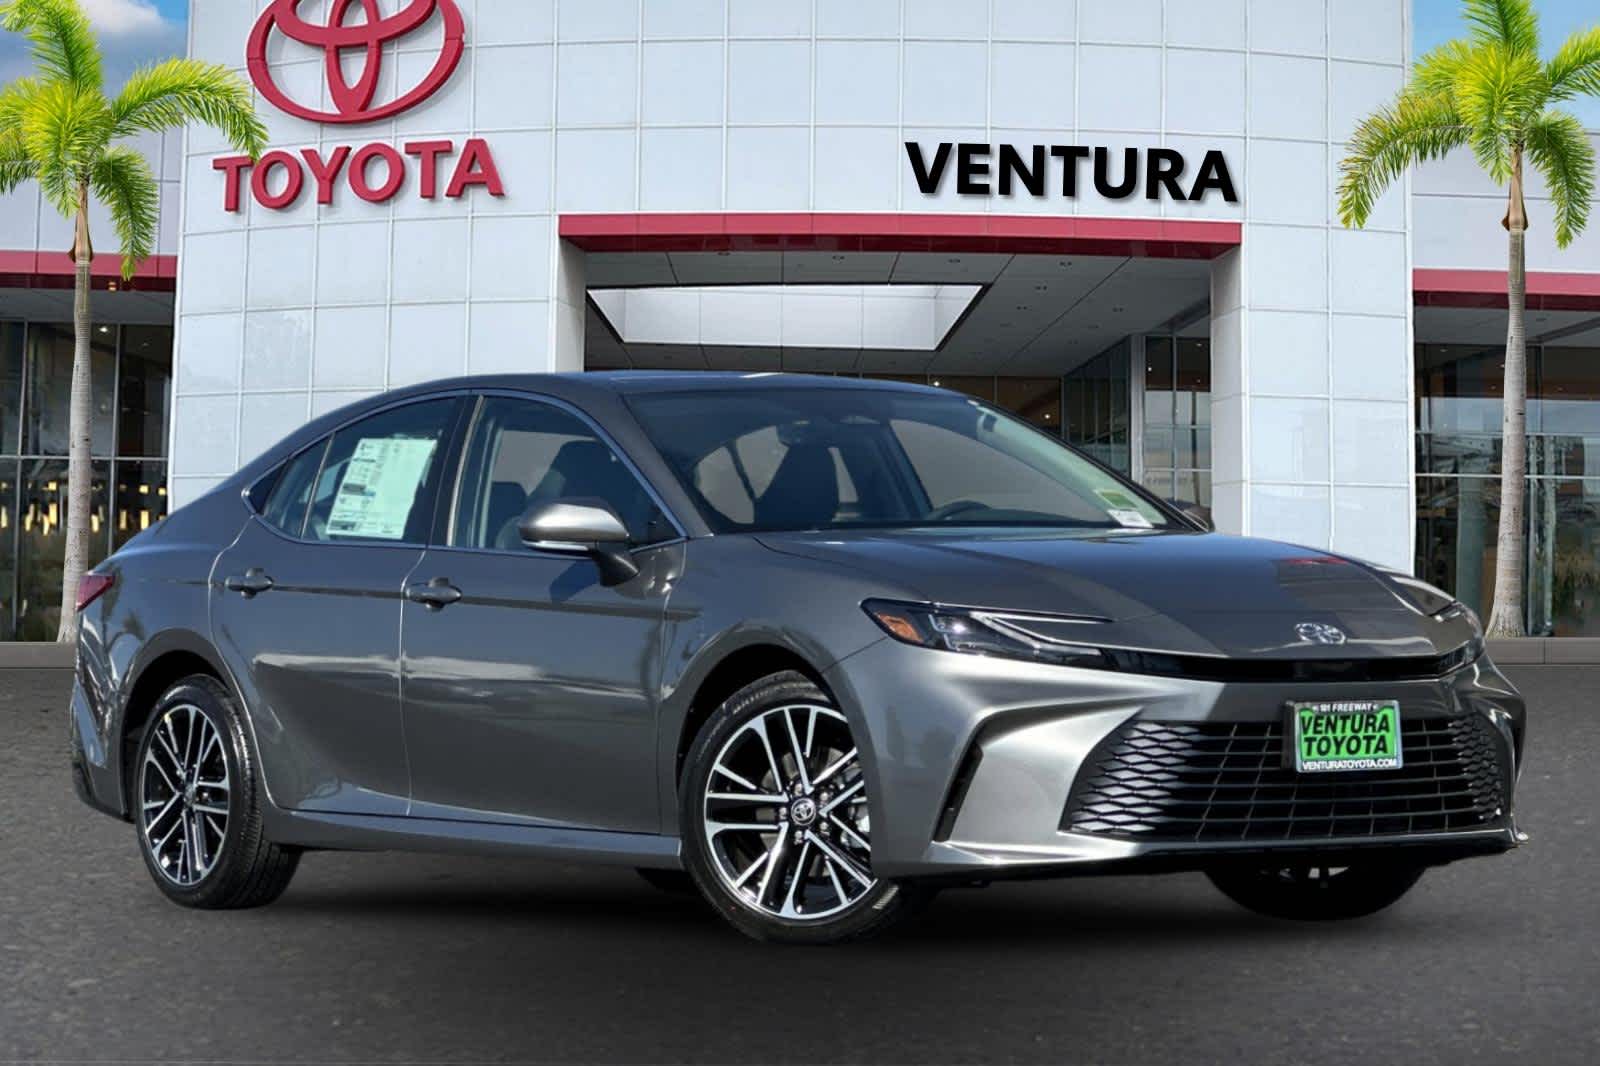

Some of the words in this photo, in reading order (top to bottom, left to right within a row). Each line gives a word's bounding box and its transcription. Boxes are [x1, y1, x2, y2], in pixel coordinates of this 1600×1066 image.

[212, 138, 505, 212] TOYOTA
[904, 141, 1239, 203] VENTURA
[1332, 703, 1372, 712] FREEWAY
[1300, 713, 1390, 735] VENTURA
[1303, 735, 1388, 756] TOYOTA
[1302, 758, 1397, 770] VENTURATOYOTA.COM
